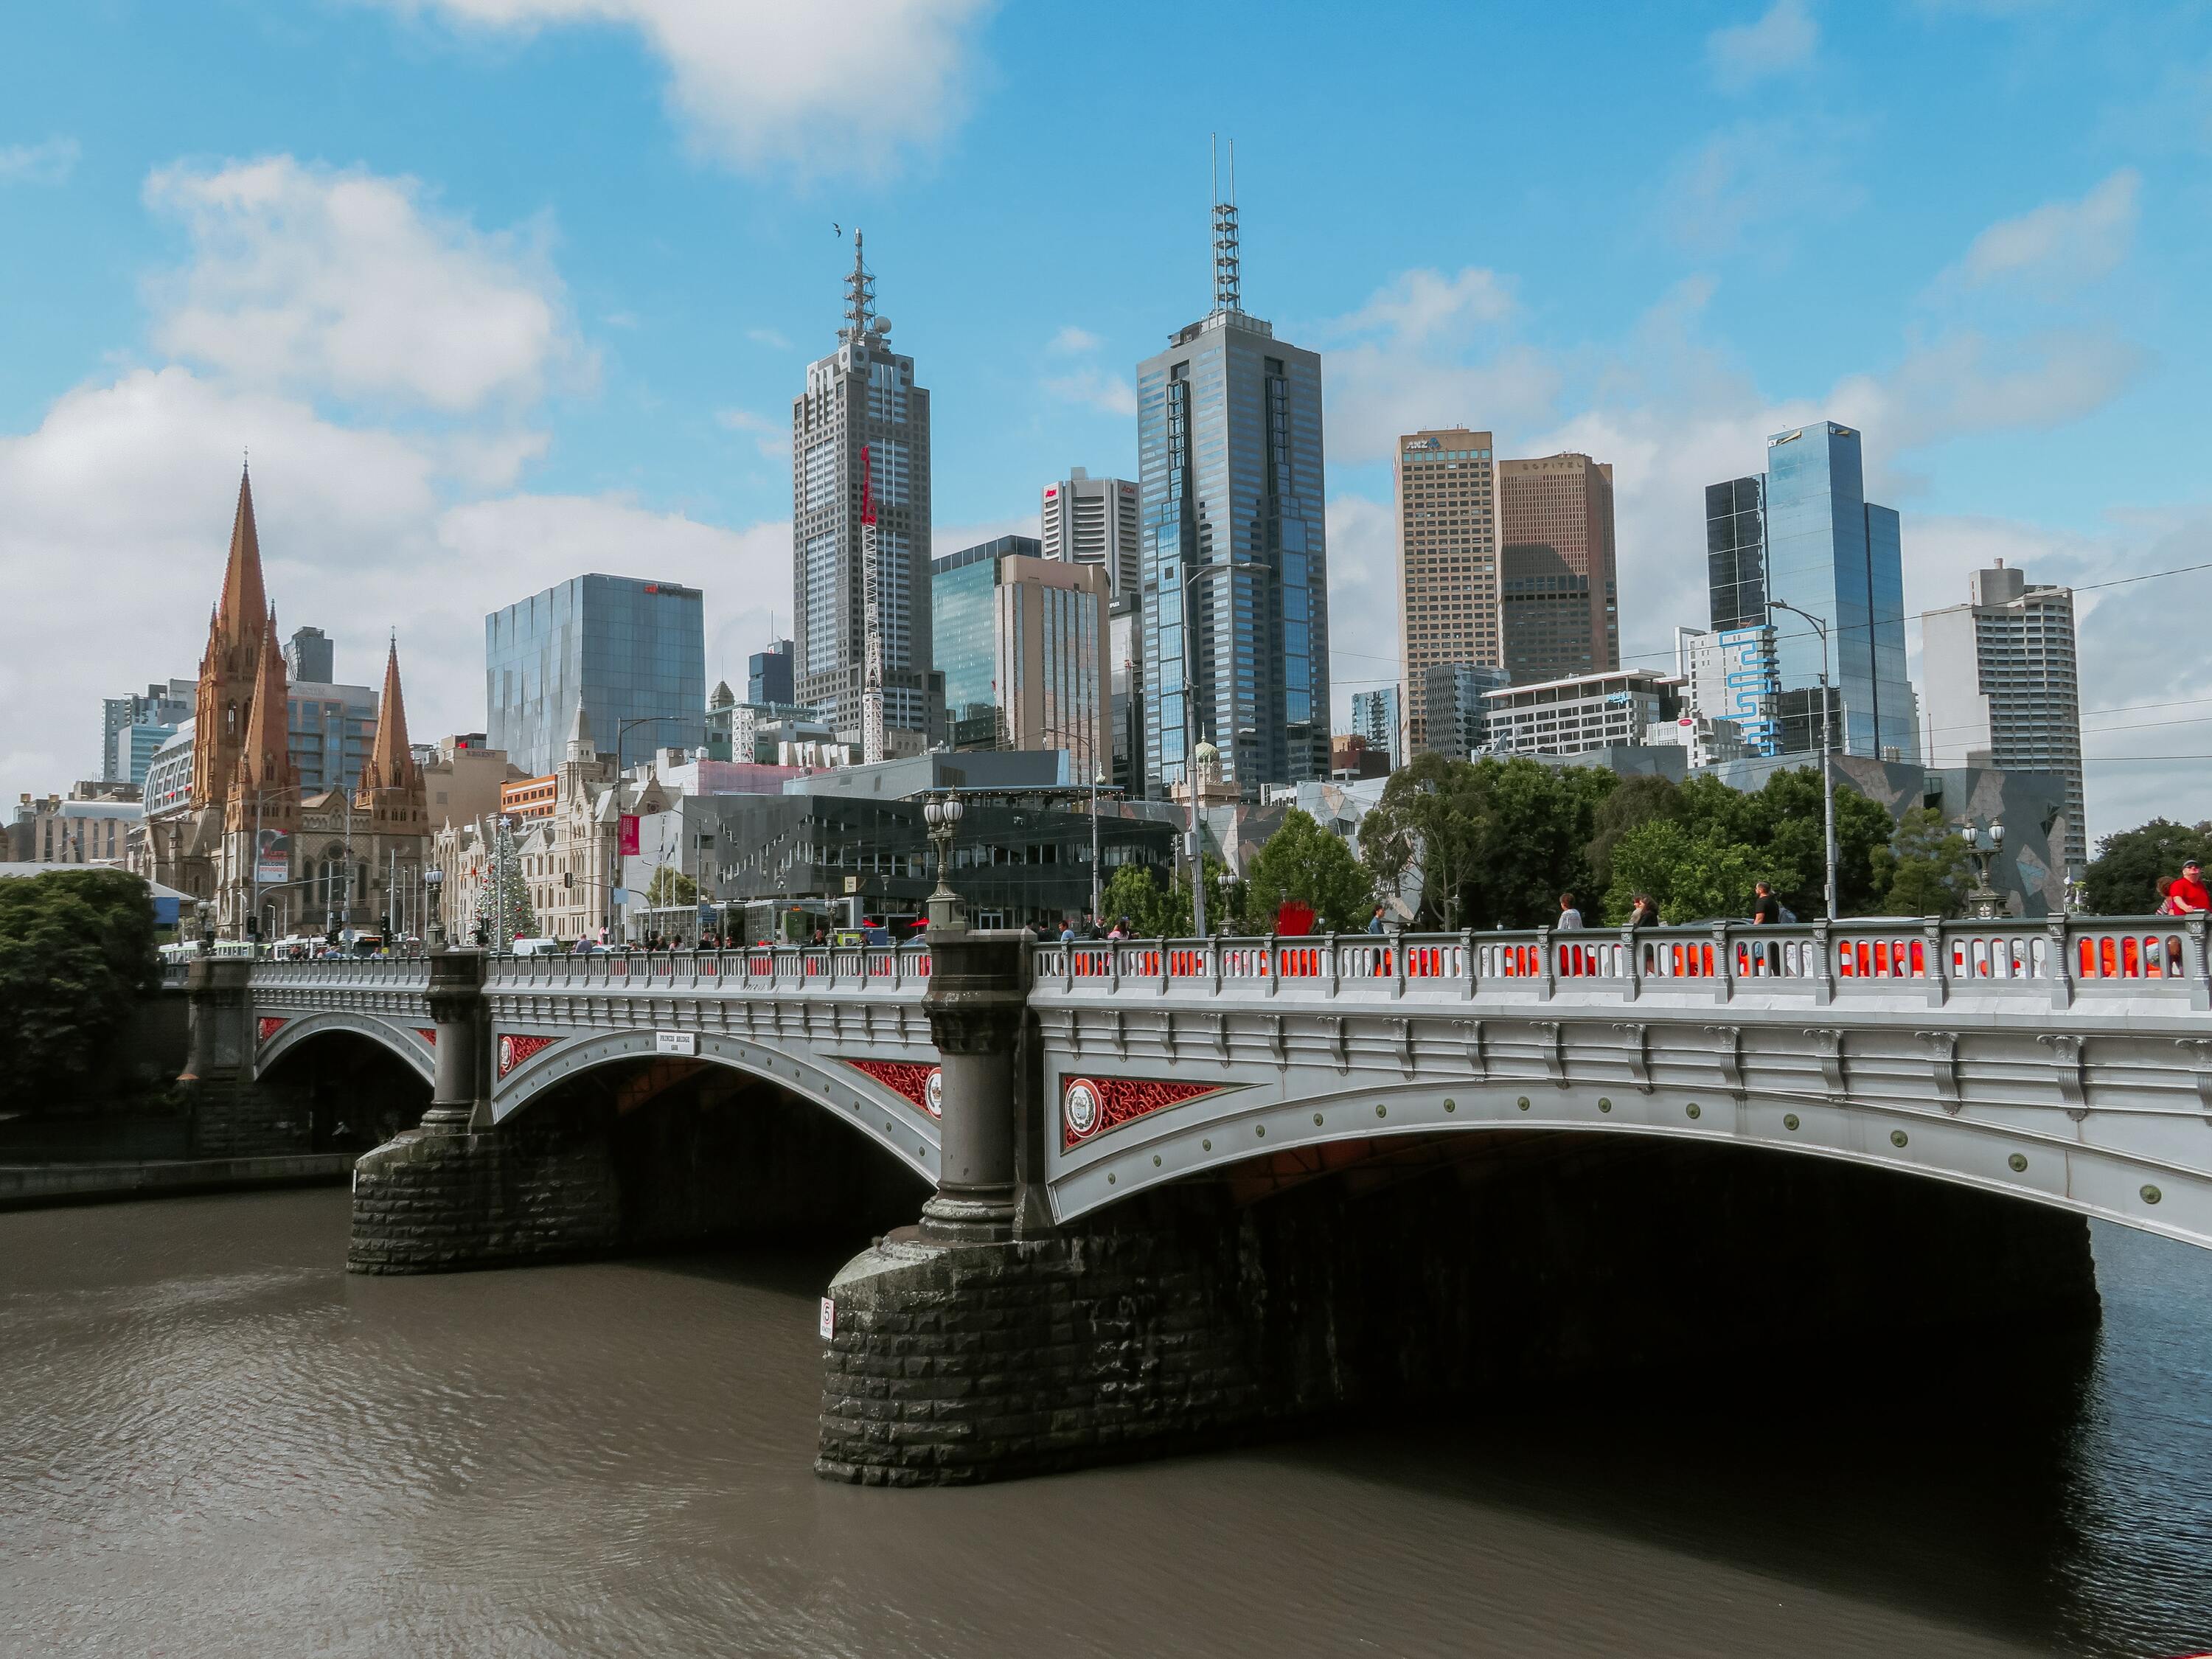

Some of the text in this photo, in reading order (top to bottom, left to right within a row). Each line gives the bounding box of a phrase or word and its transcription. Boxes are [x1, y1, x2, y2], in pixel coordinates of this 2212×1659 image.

[1406, 441, 1428, 449] ANZ
[1523, 461, 1583, 470] SOFITEL
[1046, 489, 1057, 498] AON
[1121, 484, 1135, 495] AON
[824, 1306, 830, 1321] 5
